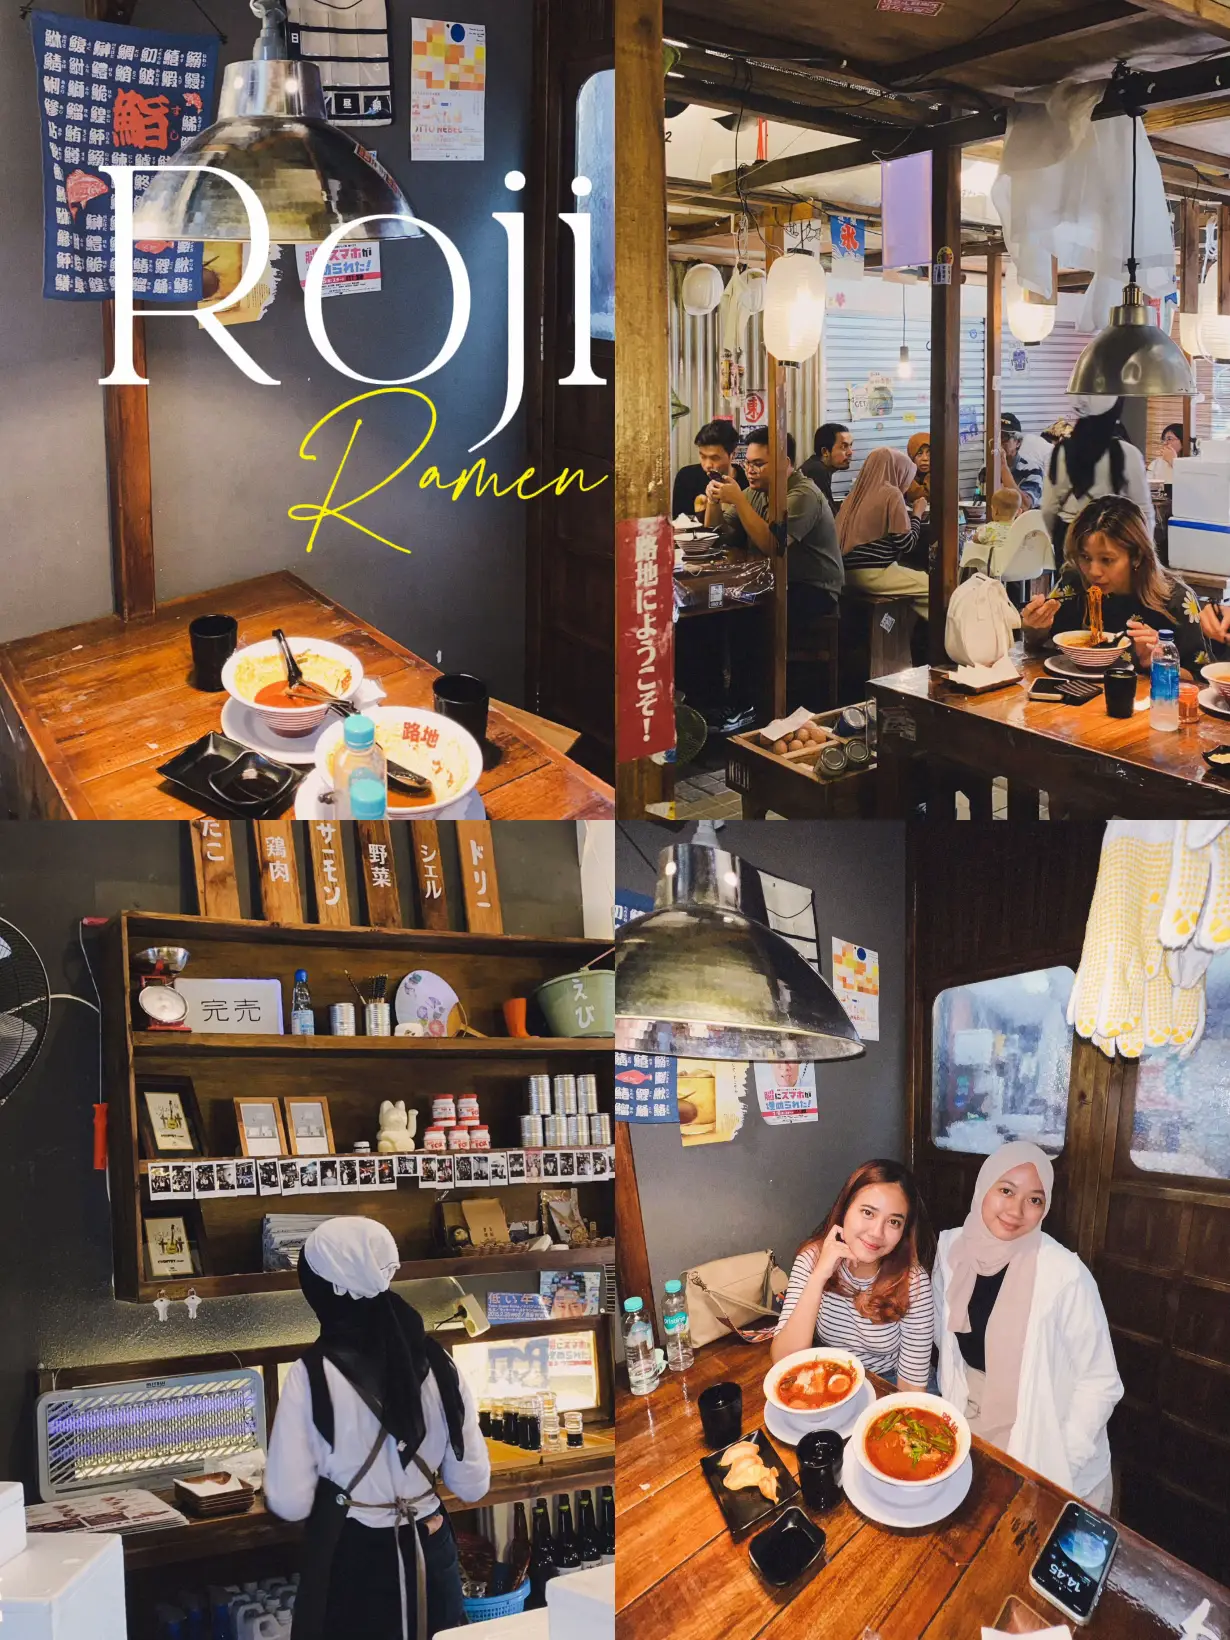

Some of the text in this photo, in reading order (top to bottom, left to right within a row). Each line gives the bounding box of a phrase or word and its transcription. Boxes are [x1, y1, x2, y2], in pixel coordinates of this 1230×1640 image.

[402, 721, 439, 748] 路地
[265, 836, 290, 883] 鶏肉
[316, 822, 342, 905] サーモン
[368, 843, 392, 888] 野菜
[201, 999, 261, 1022] 完売
[572, 979, 595, 1029] えび
